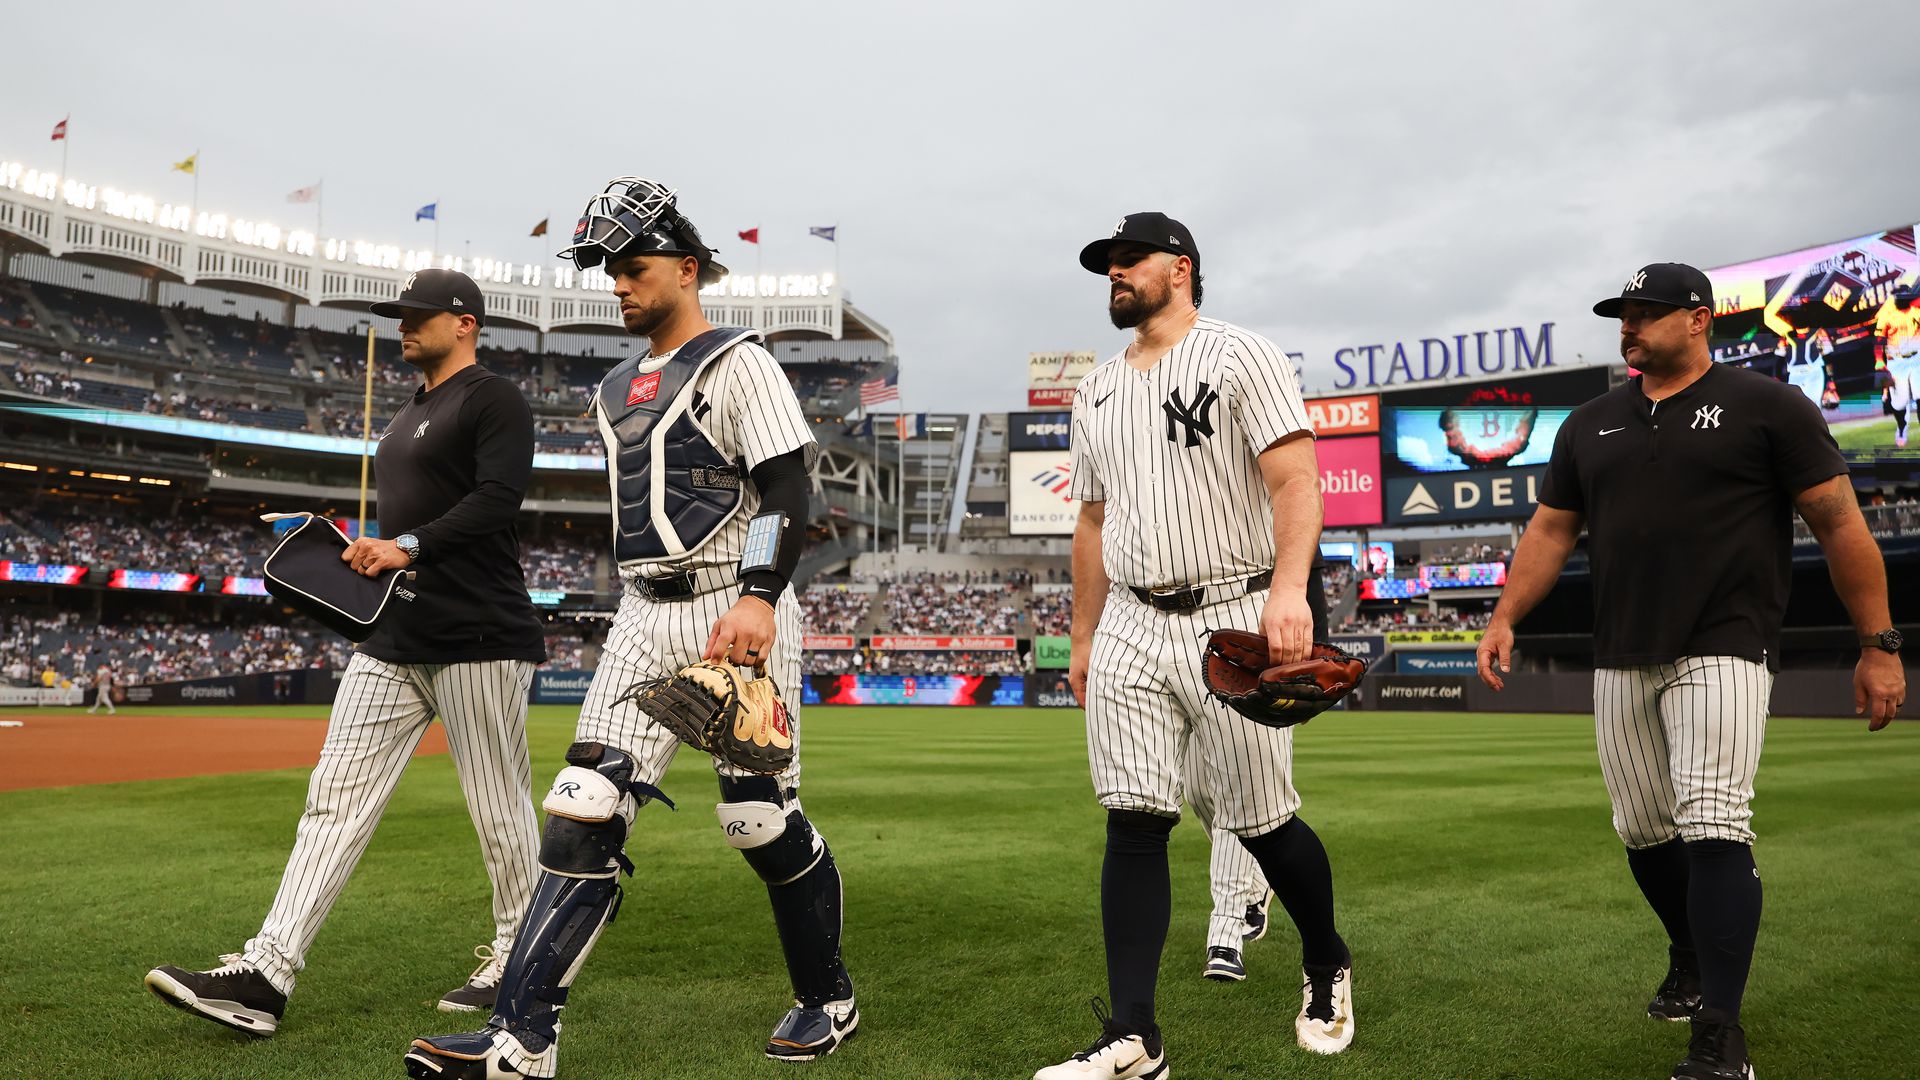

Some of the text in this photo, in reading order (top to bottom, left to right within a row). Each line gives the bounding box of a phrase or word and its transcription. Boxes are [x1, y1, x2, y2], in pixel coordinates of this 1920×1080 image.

[1625, 271, 1647, 291] NY
[1031, 356, 1095, 366] ARMITRON
[1334, 322, 1556, 389] STADIUM
[1162, 382, 1219, 448] NY
[1691, 405, 1723, 430] NY
[413, 420, 430, 438] NY
[1026, 424, 1068, 436] PEPSI
[1013, 514, 1046, 522] BANK
[1049, 514, 1064, 522] OF
[1381, 685, 1462, 699] NITTOTIRE.COM
[726, 820, 750, 837] R
